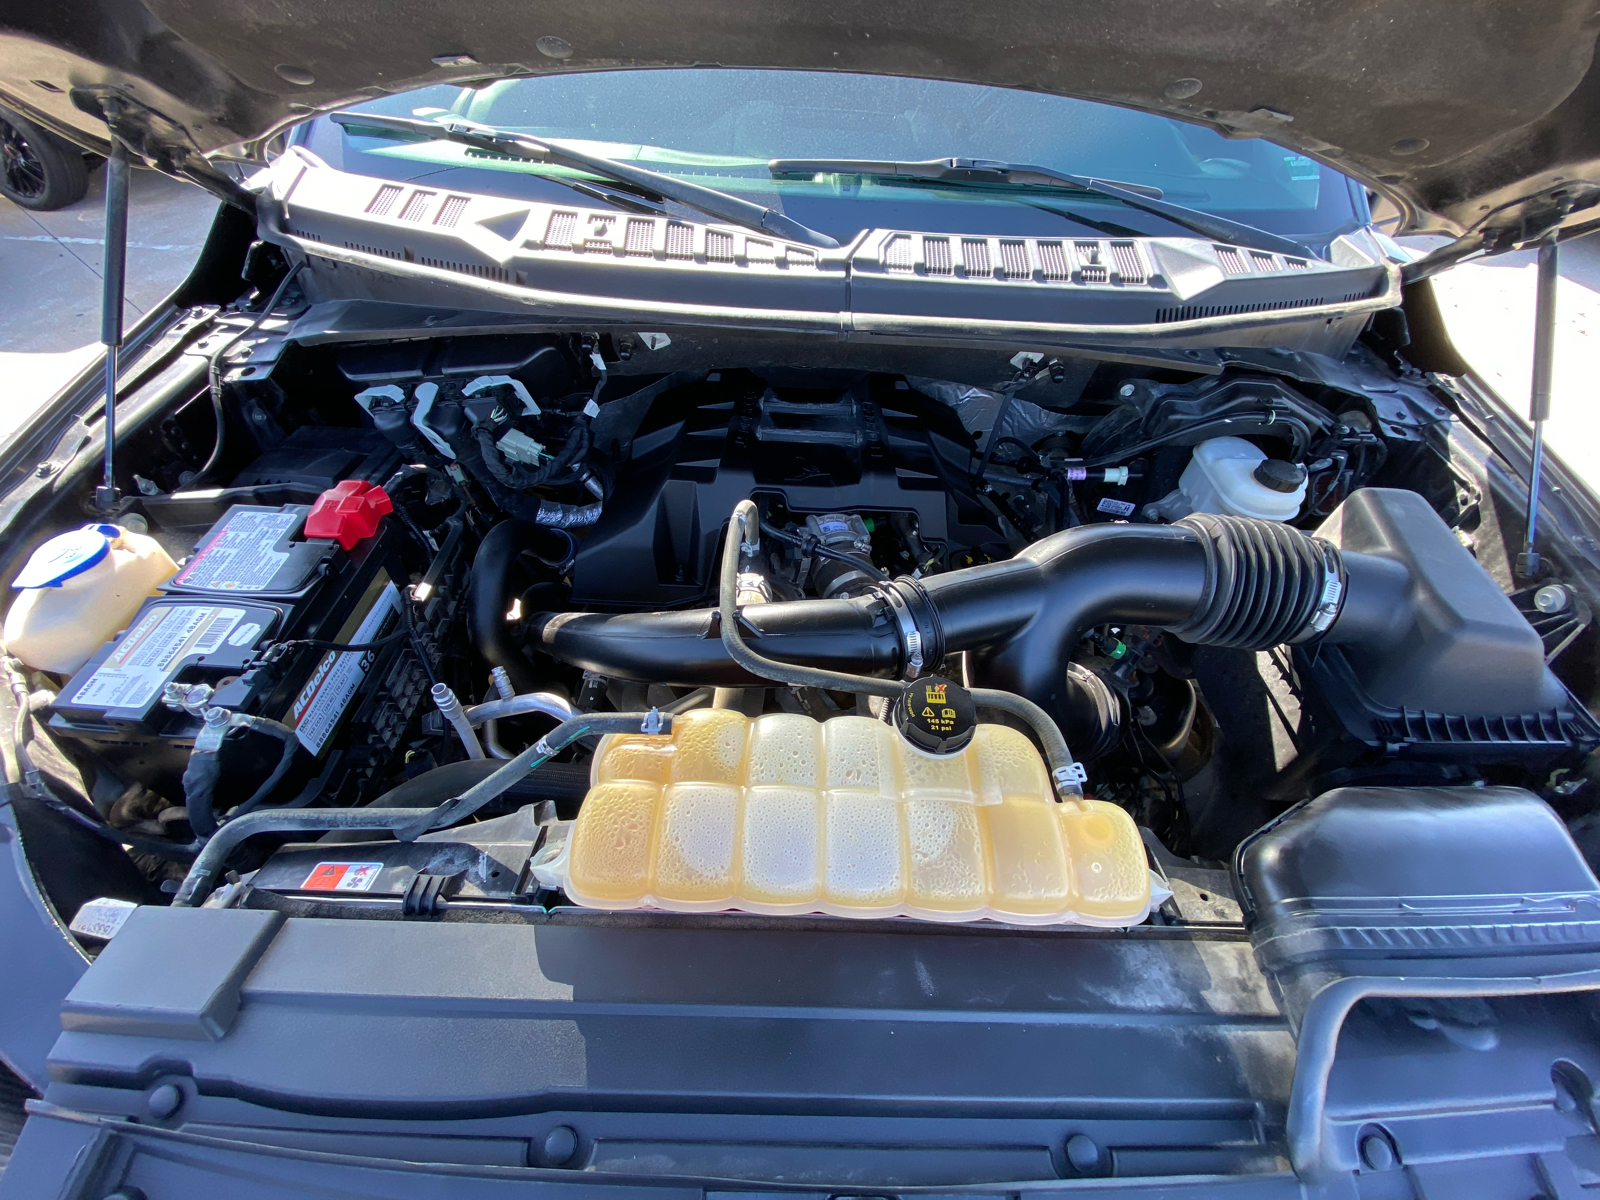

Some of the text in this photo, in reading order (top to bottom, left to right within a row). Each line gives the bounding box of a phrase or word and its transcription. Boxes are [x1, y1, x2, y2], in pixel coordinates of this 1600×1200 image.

[113, 614, 159, 662] ACDelco
[187, 612, 207, 633] 48AGM
[361, 650, 375, 672] 36
[76, 678, 98, 700] 48AGM
[293, 651, 336, 720] ACDelco
[308, 682, 332, 718] MAINTENANCE
[316, 683, 356, 748] 88864541 48AGM
